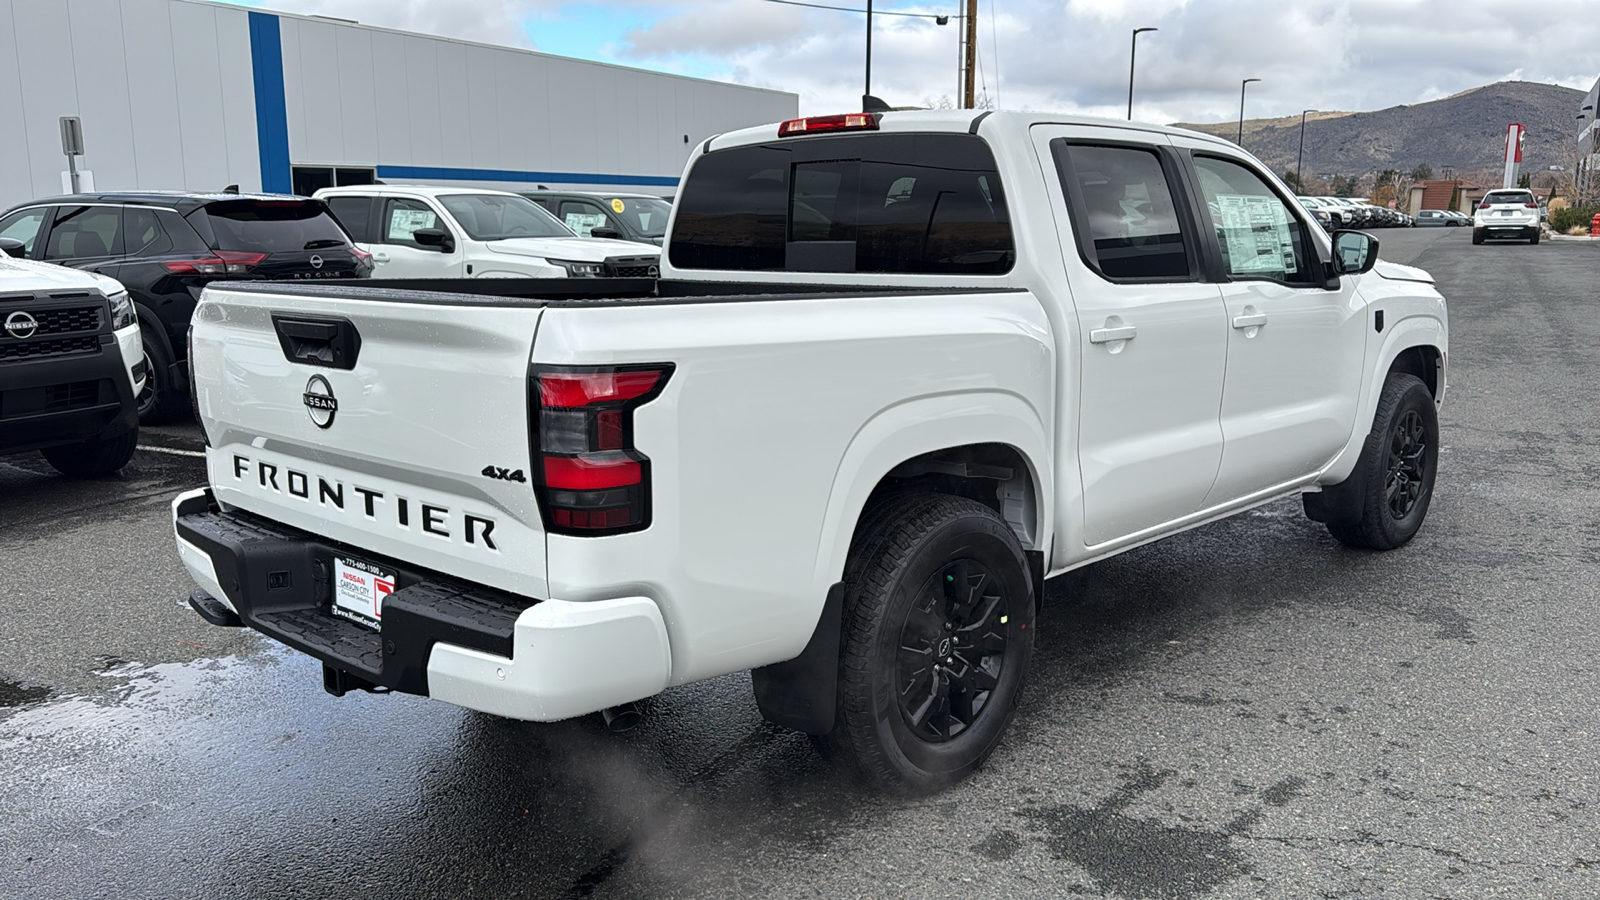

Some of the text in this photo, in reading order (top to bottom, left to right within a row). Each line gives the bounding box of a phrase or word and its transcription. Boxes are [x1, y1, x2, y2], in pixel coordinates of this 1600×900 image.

[293, 271, 341, 279] ROGUE
[4, 321, 39, 331] NISSAN
[304, 394, 336, 410] NISSAN
[232, 455, 498, 551] FRONTIER
[342, 572, 365, 585] NISSAN
[340, 579, 369, 595] CARSON CITY
